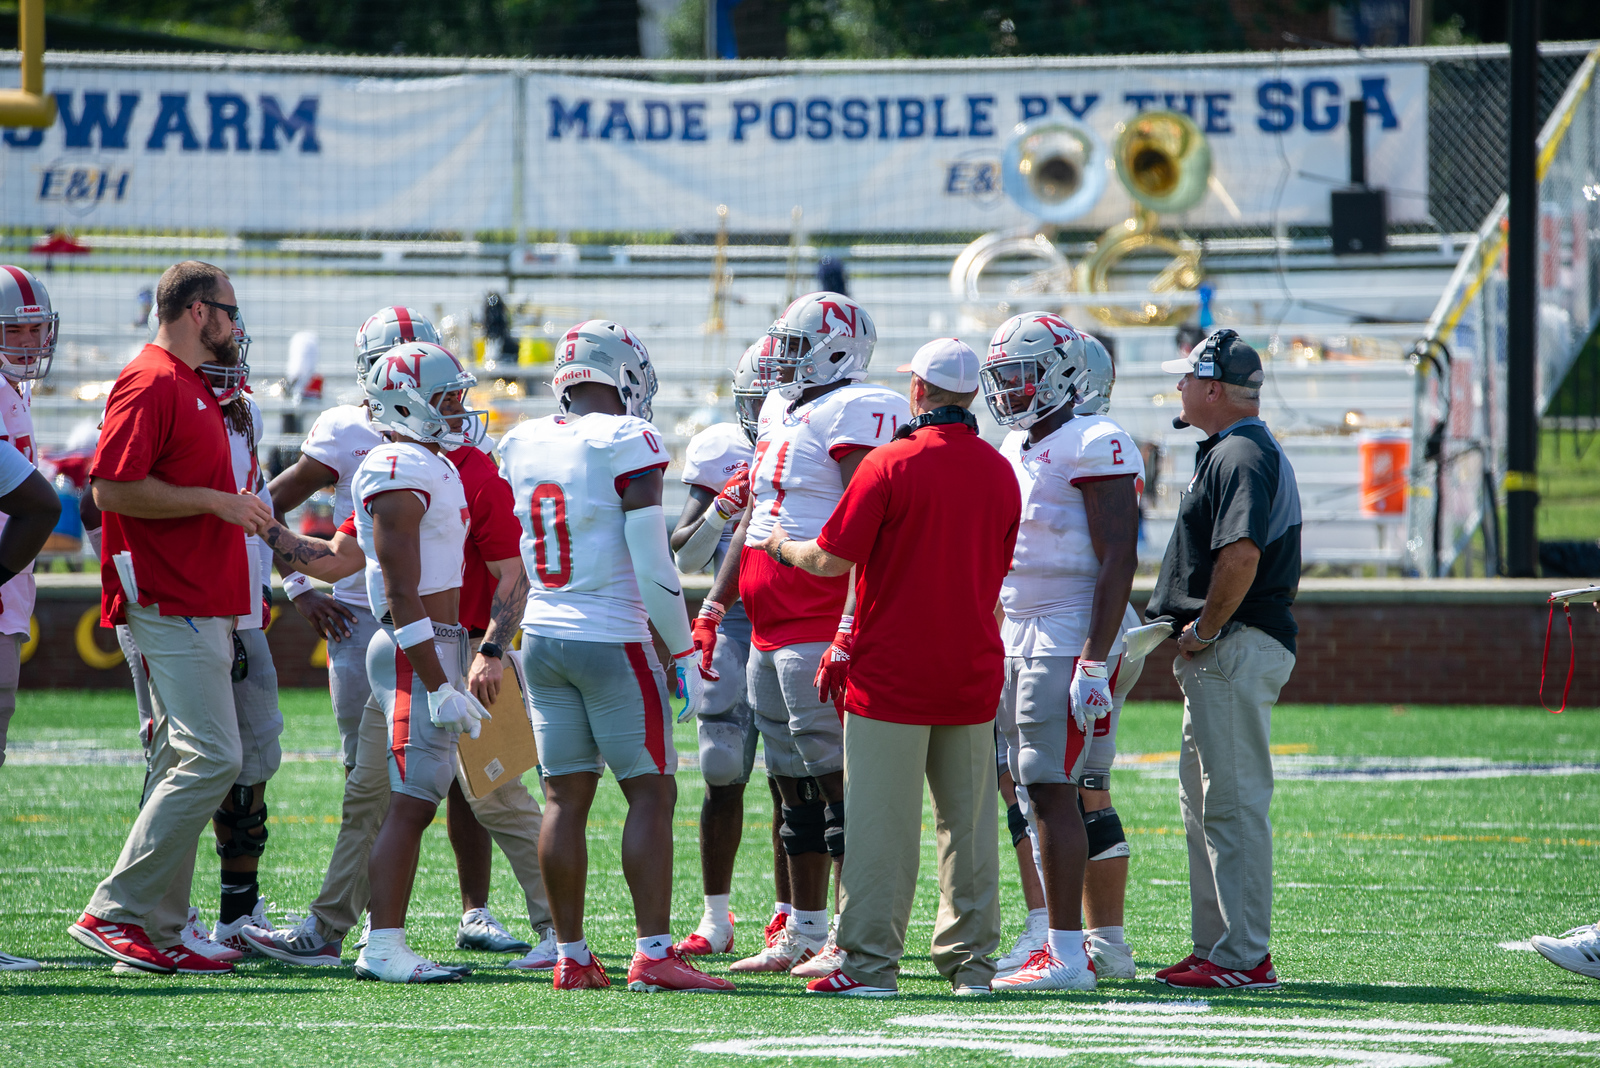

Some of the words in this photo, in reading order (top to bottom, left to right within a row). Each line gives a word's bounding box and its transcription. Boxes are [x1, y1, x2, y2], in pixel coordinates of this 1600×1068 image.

[547, 96, 707, 142] MADE
[732, 95, 998, 141] POSSIBLE
[1257, 75, 1400, 134] SGA
[38, 167, 131, 202] E&H
[947, 162, 1002, 196] E&
[816, 301, 859, 338] N
[382, 354, 426, 391] N
[554, 369, 591, 386] Riddell
[871, 412, 897, 439] 71
[643, 430, 660, 453] 0
[1111, 439, 1124, 465] 2
[386, 456, 398, 480] 7
[724, 489, 743, 504] adidas
[529, 480, 574, 591] 0
[1090, 687, 1109, 706] adidas
[220, 941, 252, 953] adidas
